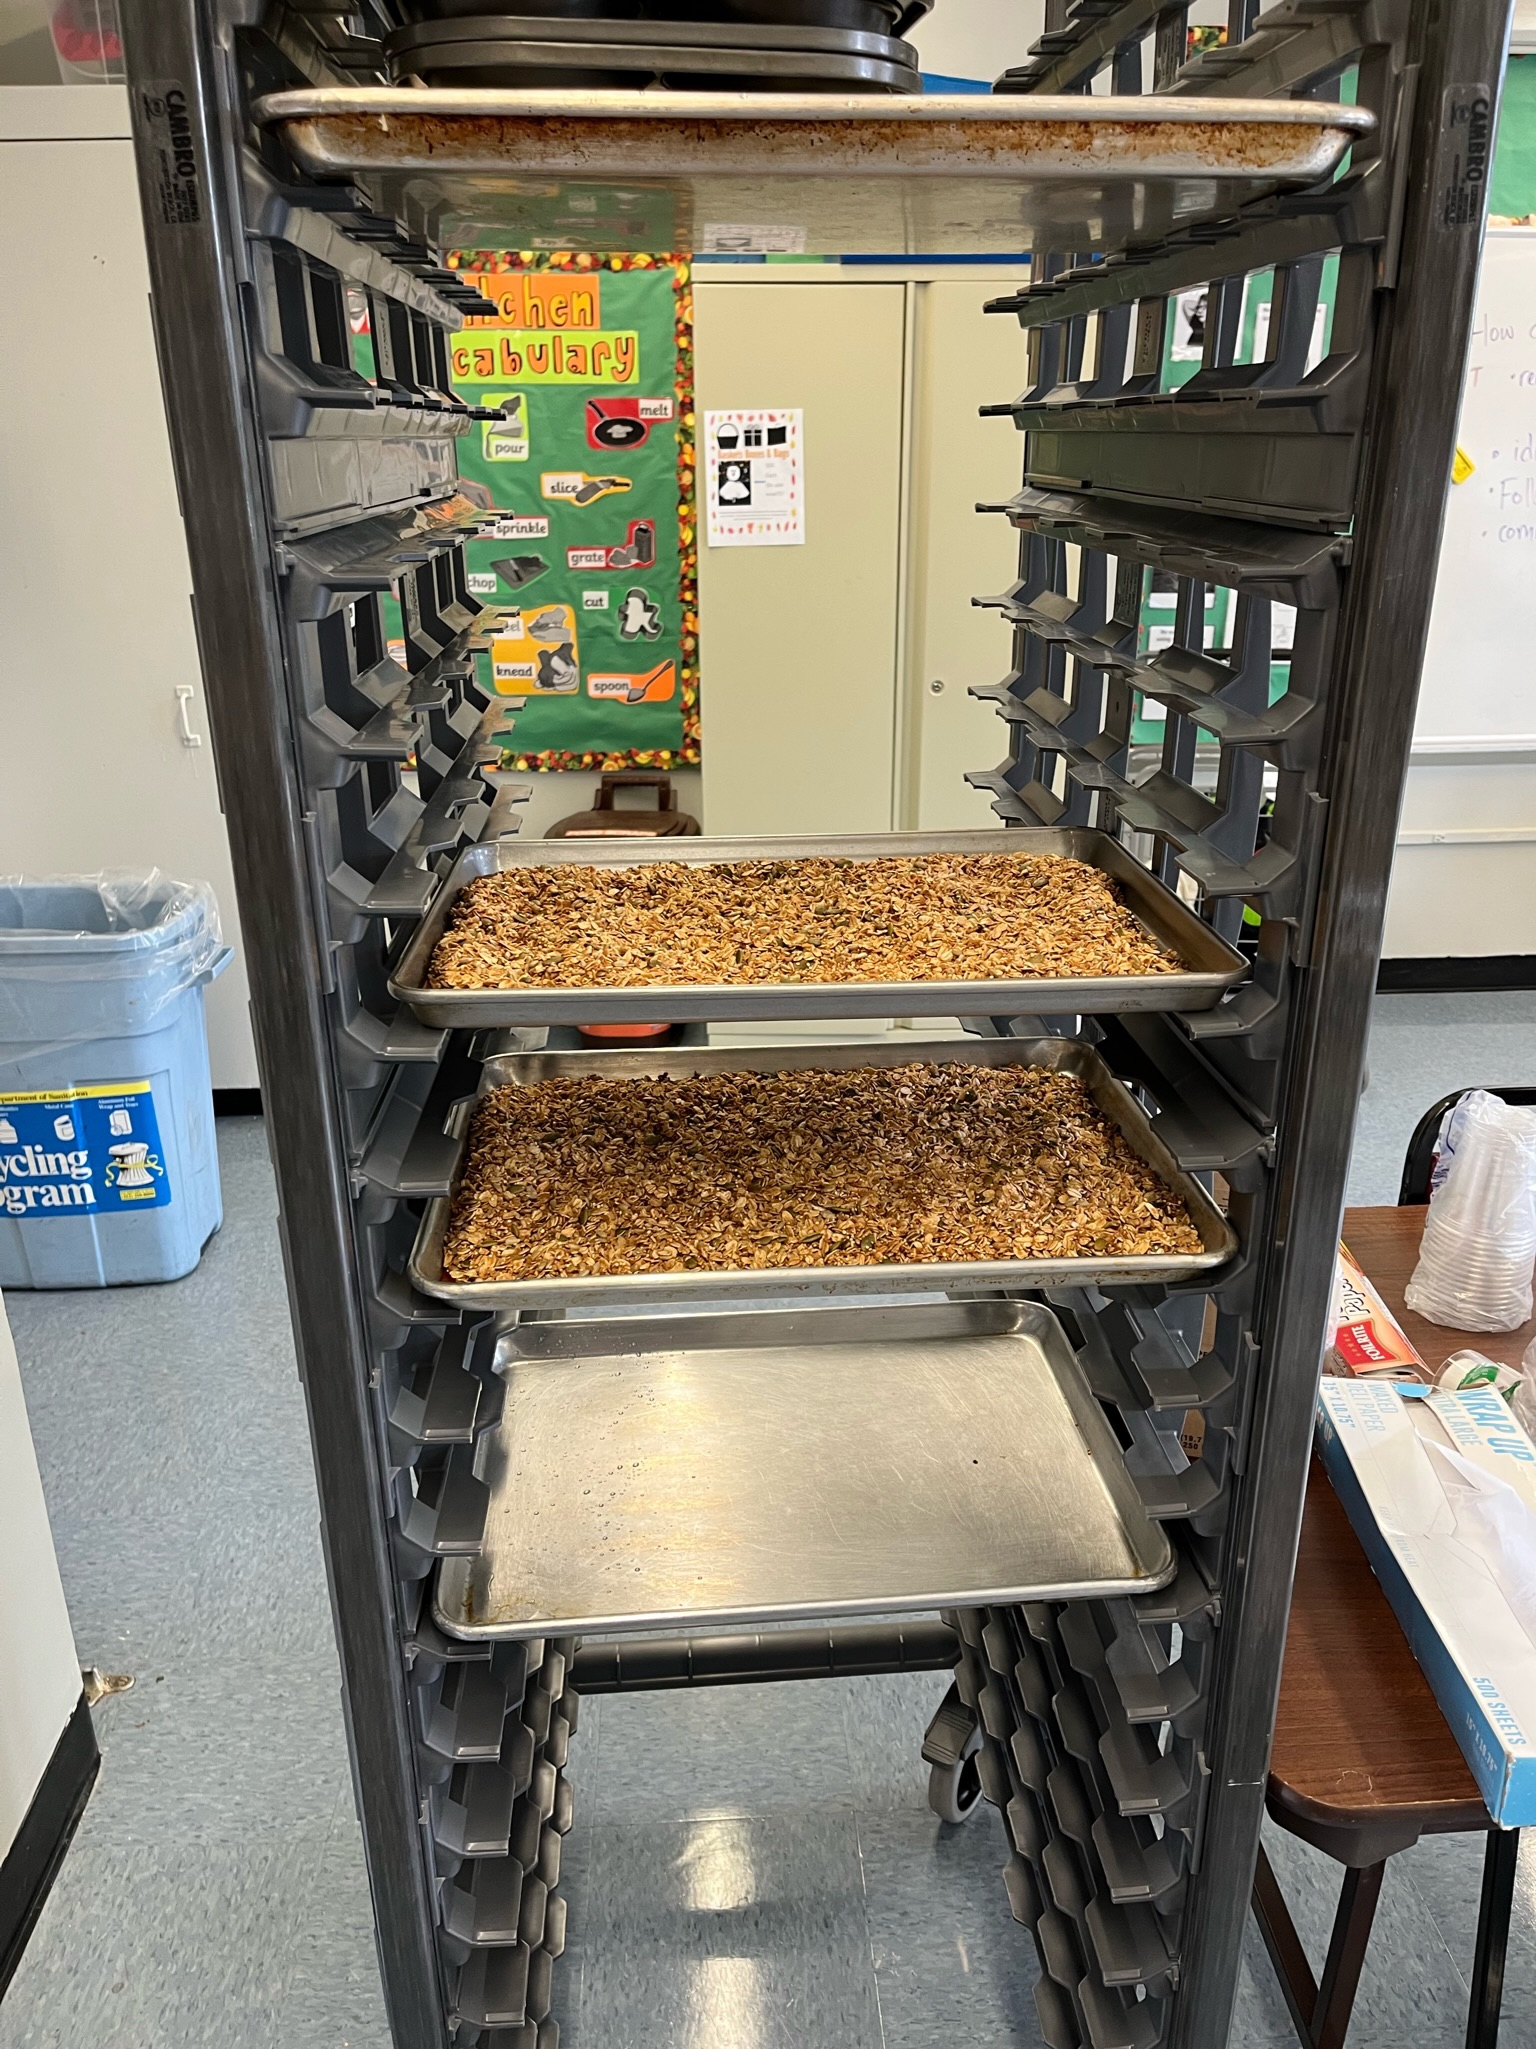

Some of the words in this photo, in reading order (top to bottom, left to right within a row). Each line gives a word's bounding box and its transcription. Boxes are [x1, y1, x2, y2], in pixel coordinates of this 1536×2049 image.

[166, 90, 196, 177] CAMBRO
[1466, 99, 1488, 181] CAMBRO
[640, 405, 669, 416] melt
[495, 443, 525, 454] pour
[550, 482, 579, 494] slice
[496, 521, 547, 535] sprinkle
[571, 553, 604, 565] grate
[467, 576, 496, 591] chop
[584, 597, 605, 608] cut
[497, 665, 533, 676] knead
[593, 682, 629, 693] spoon
[1351, 1325, 1386, 1361] FOILRITE
[1368, 1384, 1399, 1414] WAXED
[1346, 1383, 1368, 1403] DELI
[1361, 1403, 1386, 1432] PAPER
[1444, 1411, 1483, 1446] LARGE
[1455, 1387, 1516, 1435] WRAP
[1487, 1437, 1535, 1463] UP
[1473, 1677, 1499, 1698] 500
[1488, 1703, 1527, 1746] SHEETS
